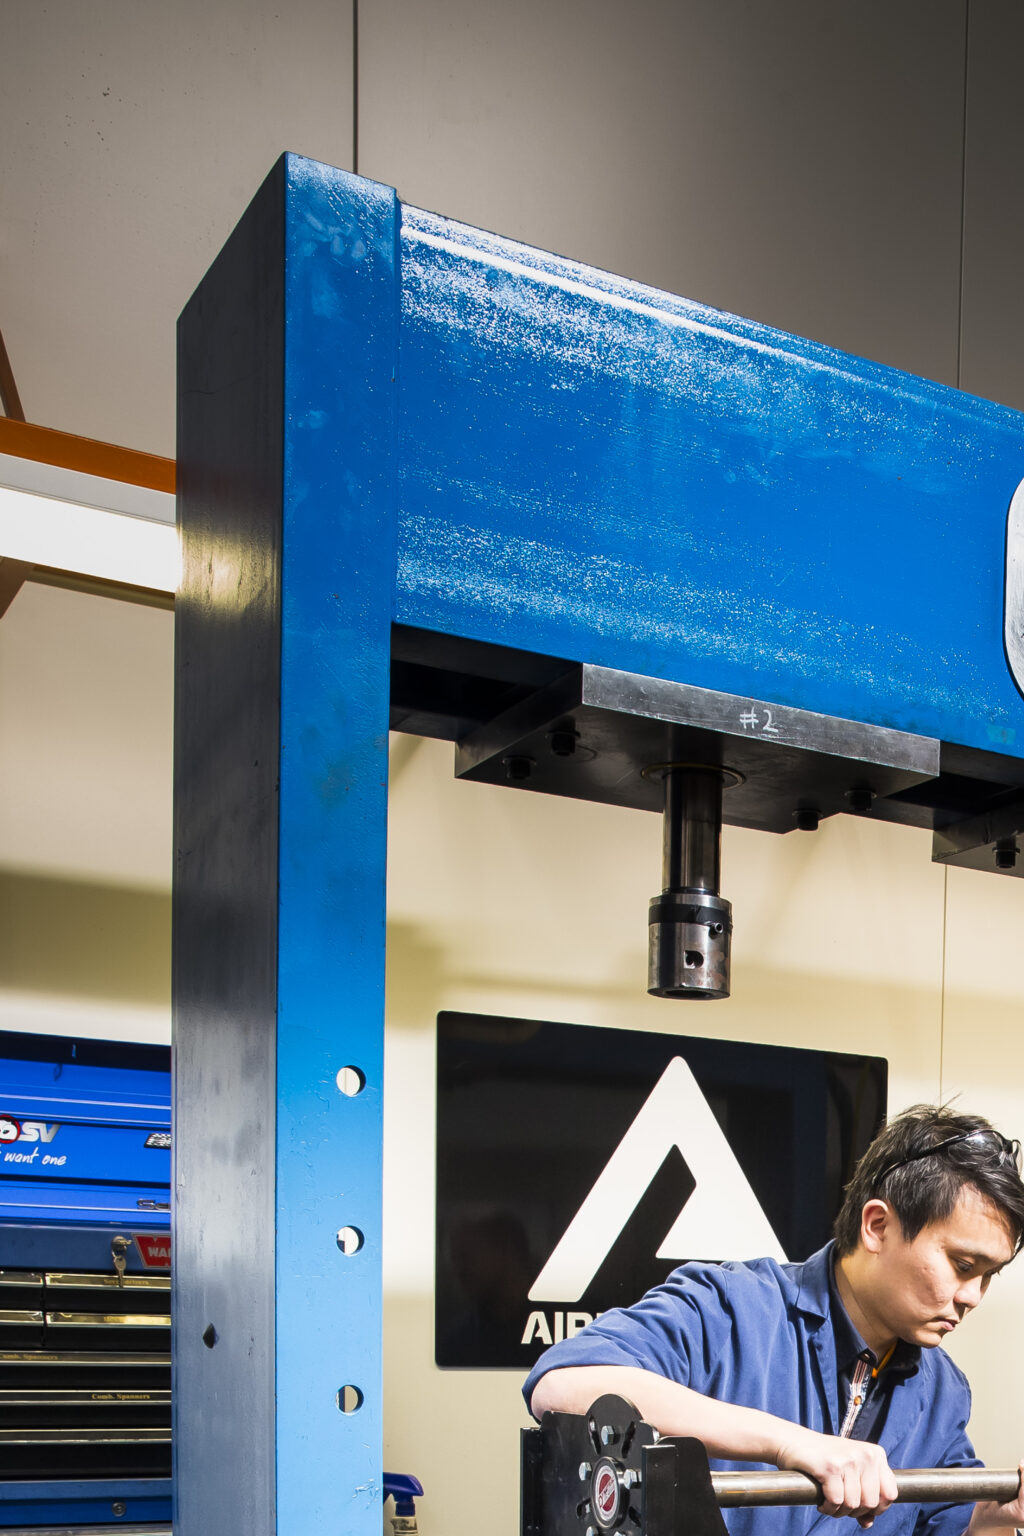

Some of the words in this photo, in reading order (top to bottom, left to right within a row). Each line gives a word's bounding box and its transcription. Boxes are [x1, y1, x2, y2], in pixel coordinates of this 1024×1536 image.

[739, 707, 779, 733] #2
[4, 1147, 39, 1164] want
[42, 1154, 67, 1166] one
[521, 1310, 604, 1345] AIR
